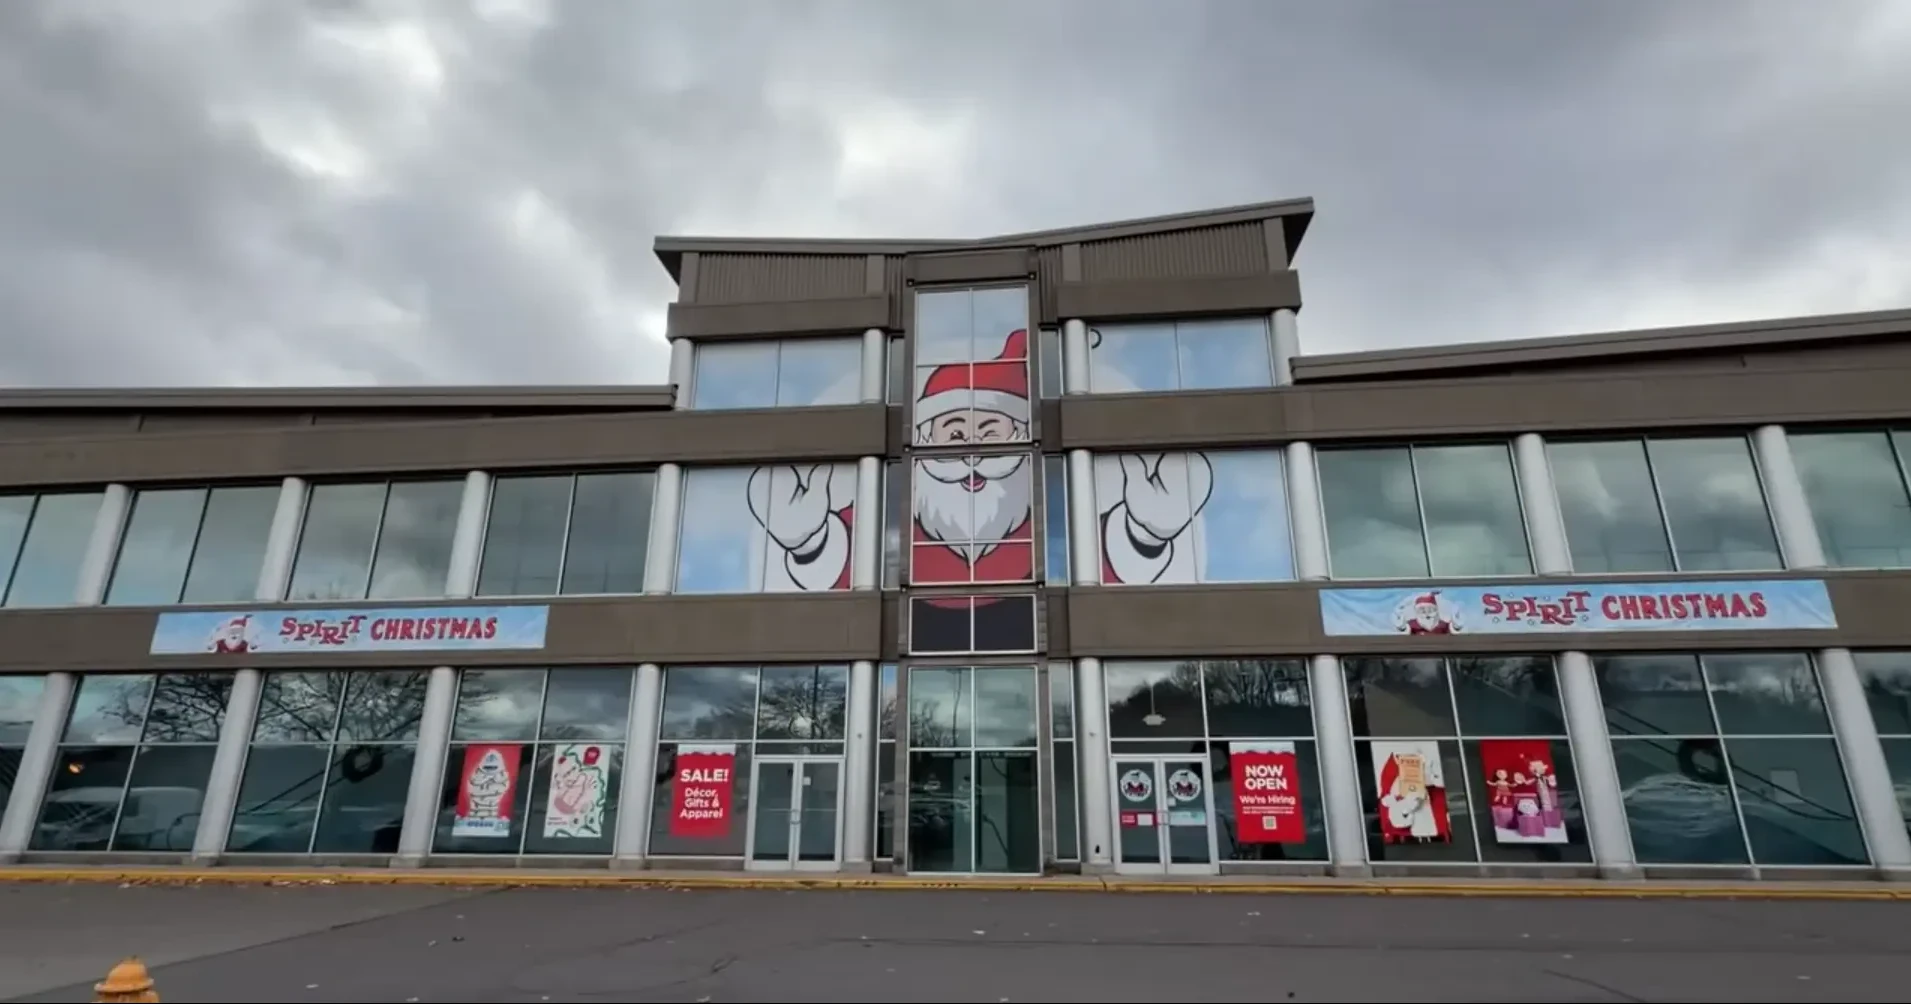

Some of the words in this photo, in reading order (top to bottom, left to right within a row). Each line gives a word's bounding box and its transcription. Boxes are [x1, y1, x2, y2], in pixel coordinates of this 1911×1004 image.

[1481, 590, 1592, 626] SPIRIT
[1601, 592, 1768, 621] CHRISTMAS
[279, 615, 368, 645] SPIRIT
[370, 617, 498, 641] CHRISTMAS
[680, 768, 729, 783] SALE!
[1244, 764, 1284, 778] NOW
[1244, 778, 1288, 790] OPEN
[684, 797, 710, 809] Gifts
[1239, 795, 1267, 804] We're
[1267, 795, 1296, 806] Hiring
[679, 808, 724, 820] Apparel
